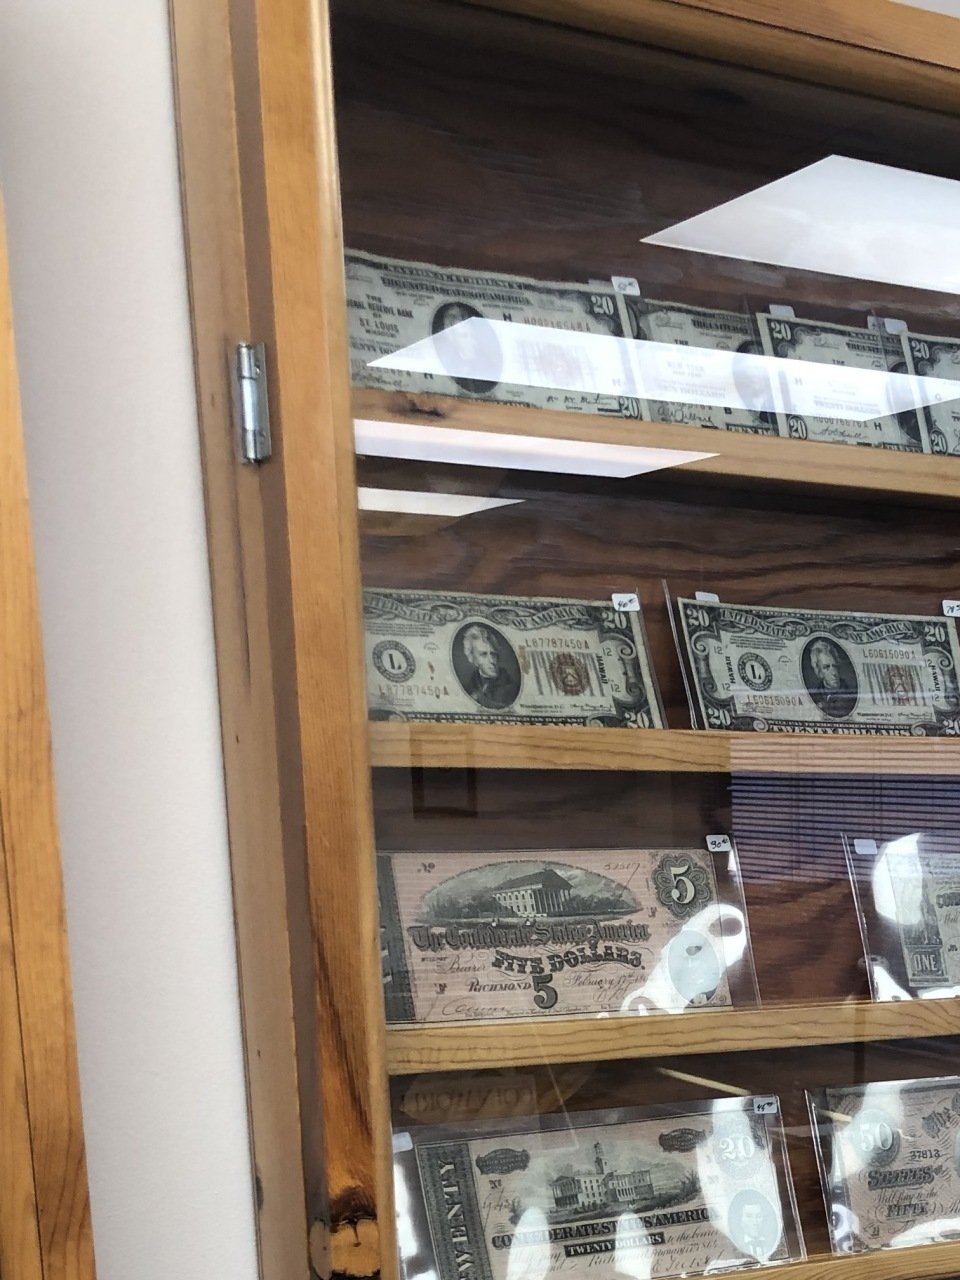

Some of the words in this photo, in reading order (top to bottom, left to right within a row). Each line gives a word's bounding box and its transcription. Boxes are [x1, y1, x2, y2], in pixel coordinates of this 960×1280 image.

[592, 295, 615, 316] 20
[771, 322, 792, 340] 20
[912, 341, 930, 359] 20
[687, 608, 710, 627] 20
[866, 621, 913, 641] AMERICA
[925, 626, 945, 643] 20
[710, 707, 731, 726] 20
[671, 865, 695, 905] 5
[914, 954, 938, 973] ONE
[468, 980, 532, 993] RICHMOND
[533, 974, 558, 1010] 5
[859, 1121, 894, 1153] 50
[719, 1136, 757, 1161] 20
[567, 1239, 613, 1257] TWENTY
